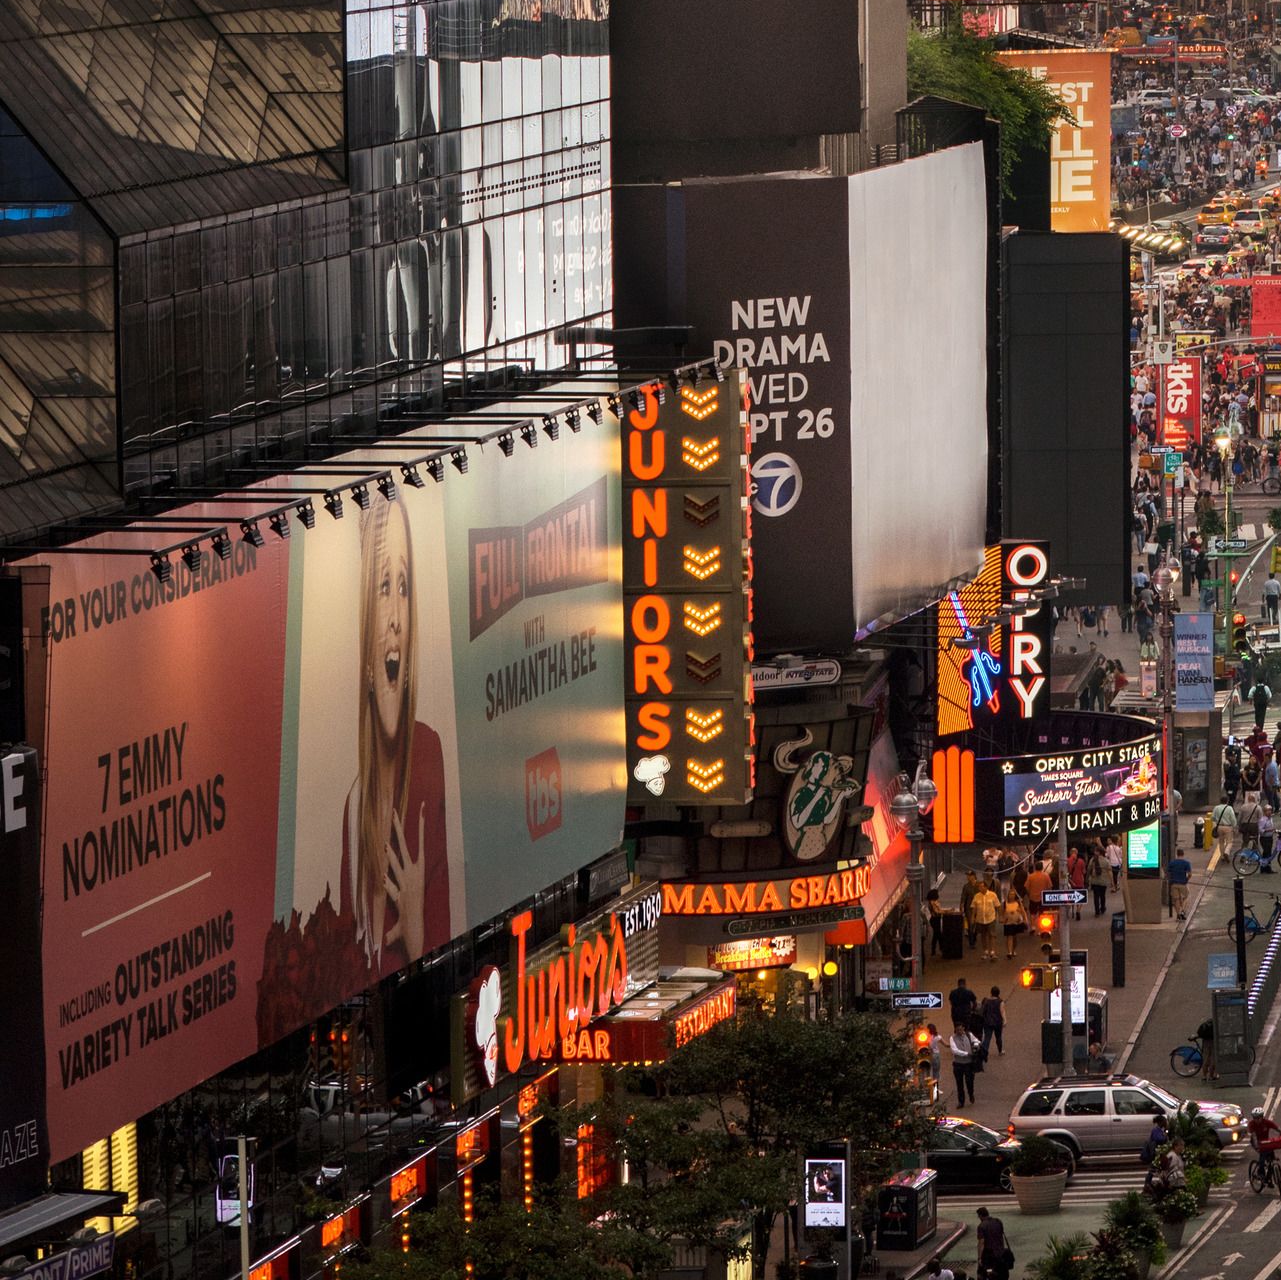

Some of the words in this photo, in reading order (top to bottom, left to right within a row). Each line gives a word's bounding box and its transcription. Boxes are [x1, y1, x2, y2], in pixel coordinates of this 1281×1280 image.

[730, 294, 812, 332] NEW
[712, 332, 832, 370] DRAMA
[1167, 362, 1194, 415] tkts
[796, 406, 835, 441] 26
[474, 537, 523, 620] FULL
[525, 498, 598, 587] FRONTAL
[628, 383, 673, 752] JUNIORS
[41, 596, 79, 650] FOR
[79, 581, 129, 634] YOUR
[523, 615, 546, 649] WITH
[1006, 545, 1047, 719] OPRY
[486, 650, 565, 723] SAMANTHA
[568, 636, 598, 685] BEE
[1176, 662, 1201, 670] DEAR
[1177, 676, 1212, 684] HANSEN
[97, 754, 114, 815] 7
[118, 723, 189, 807] EMMY
[1035, 755, 1074, 773] OPRY
[1082, 750, 1114, 768] CITY
[1119, 742, 1150, 763] STAGE
[1040, 774, 1060, 782] TIMES
[1059, 770, 1084, 781] SQUARE
[526, 770, 562, 832] tbs
[1018, 789, 1072, 815] Southern
[1069, 776, 1102, 805] Flair
[1130, 804, 1139, 821] &
[1144, 797, 1161, 818] BAR
[62, 772, 228, 902] NOMINATIONS
[662, 880, 784, 915] MAMA
[790, 864, 872, 908] SBARRO
[58, 976, 112, 1031] INCLUDING
[114, 909, 236, 1008] OUTSTANDING
[504, 910, 629, 1075] Junior's
[58, 1014, 133, 1091] VARIETY
[134, 992, 179, 1051] TALK
[181, 962, 237, 1023] SERIES
[675, 987, 736, 1049] RESTAURANT
[919, 997, 936, 1006] WAY
[562, 1030, 611, 1060] BAR
[72, 1239, 111, 1278] PRIME
